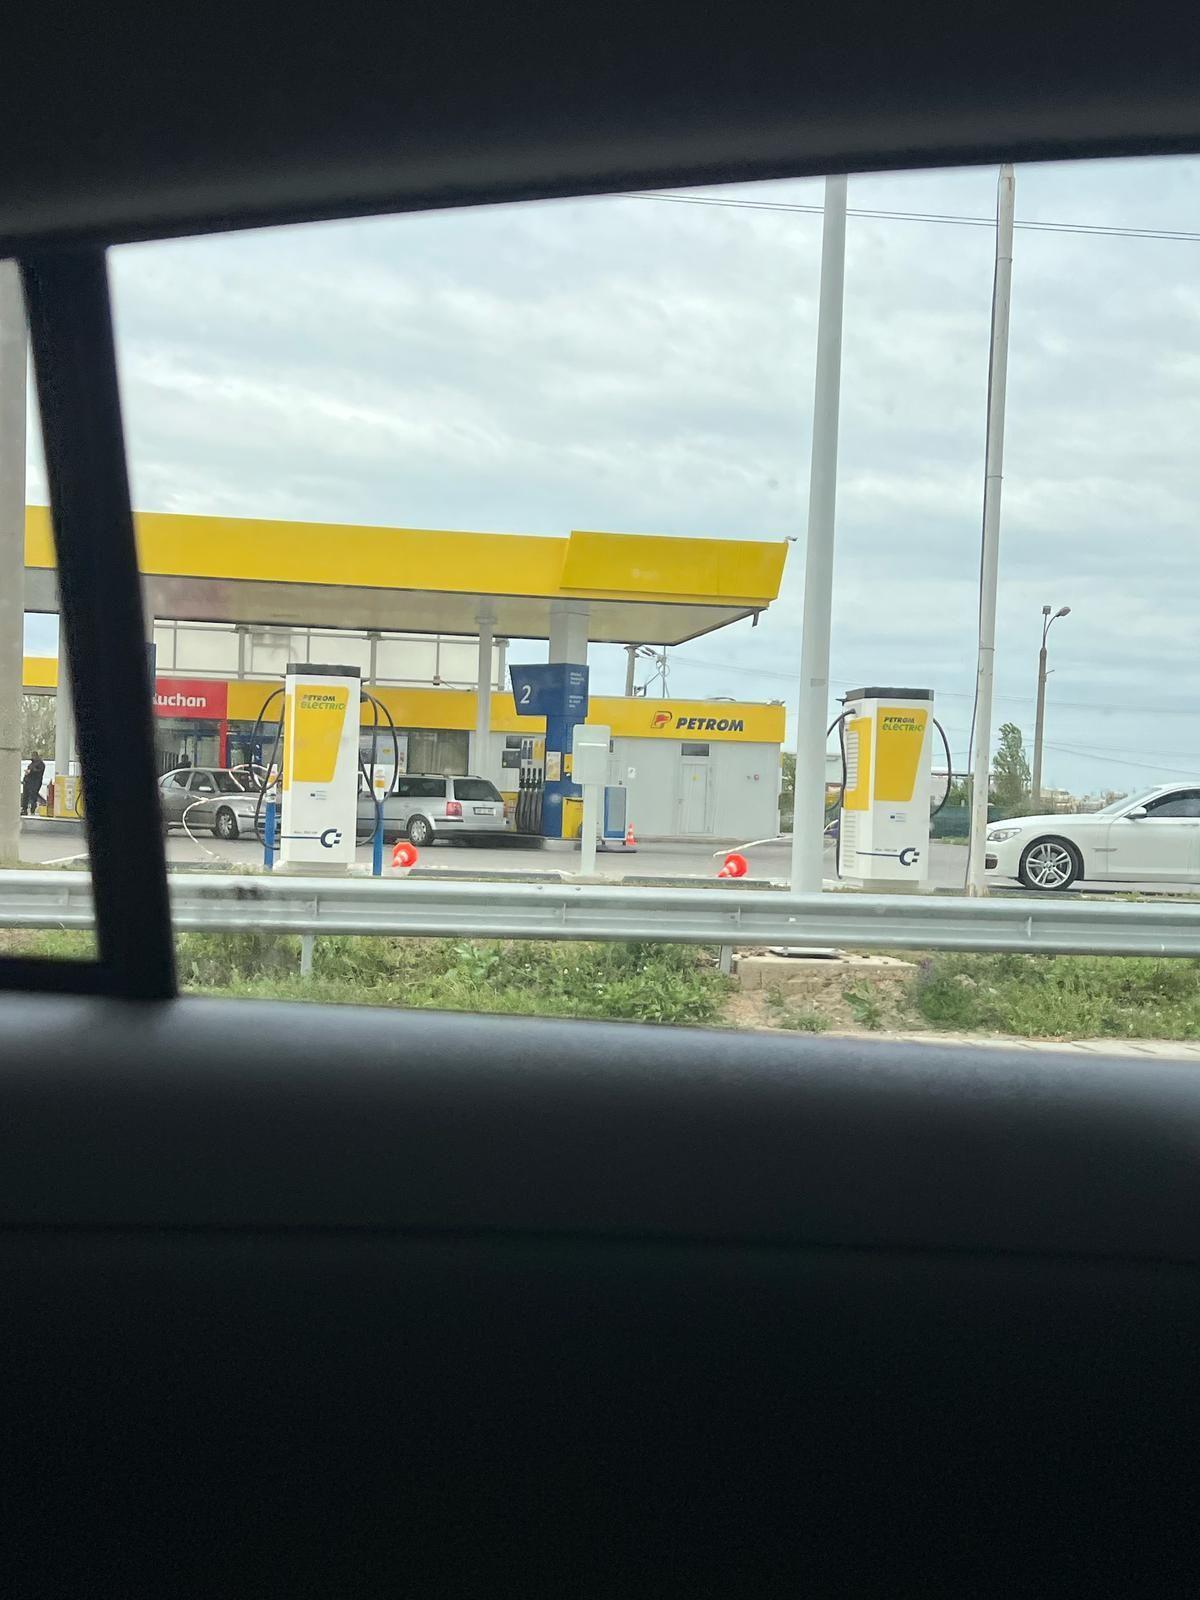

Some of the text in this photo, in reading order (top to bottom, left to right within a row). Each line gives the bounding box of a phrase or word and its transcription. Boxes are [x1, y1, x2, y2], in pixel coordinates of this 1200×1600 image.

[519, 684, 531, 704] 2
[675, 717, 744, 732] PETROM
[883, 716, 915, 724] PETROM
